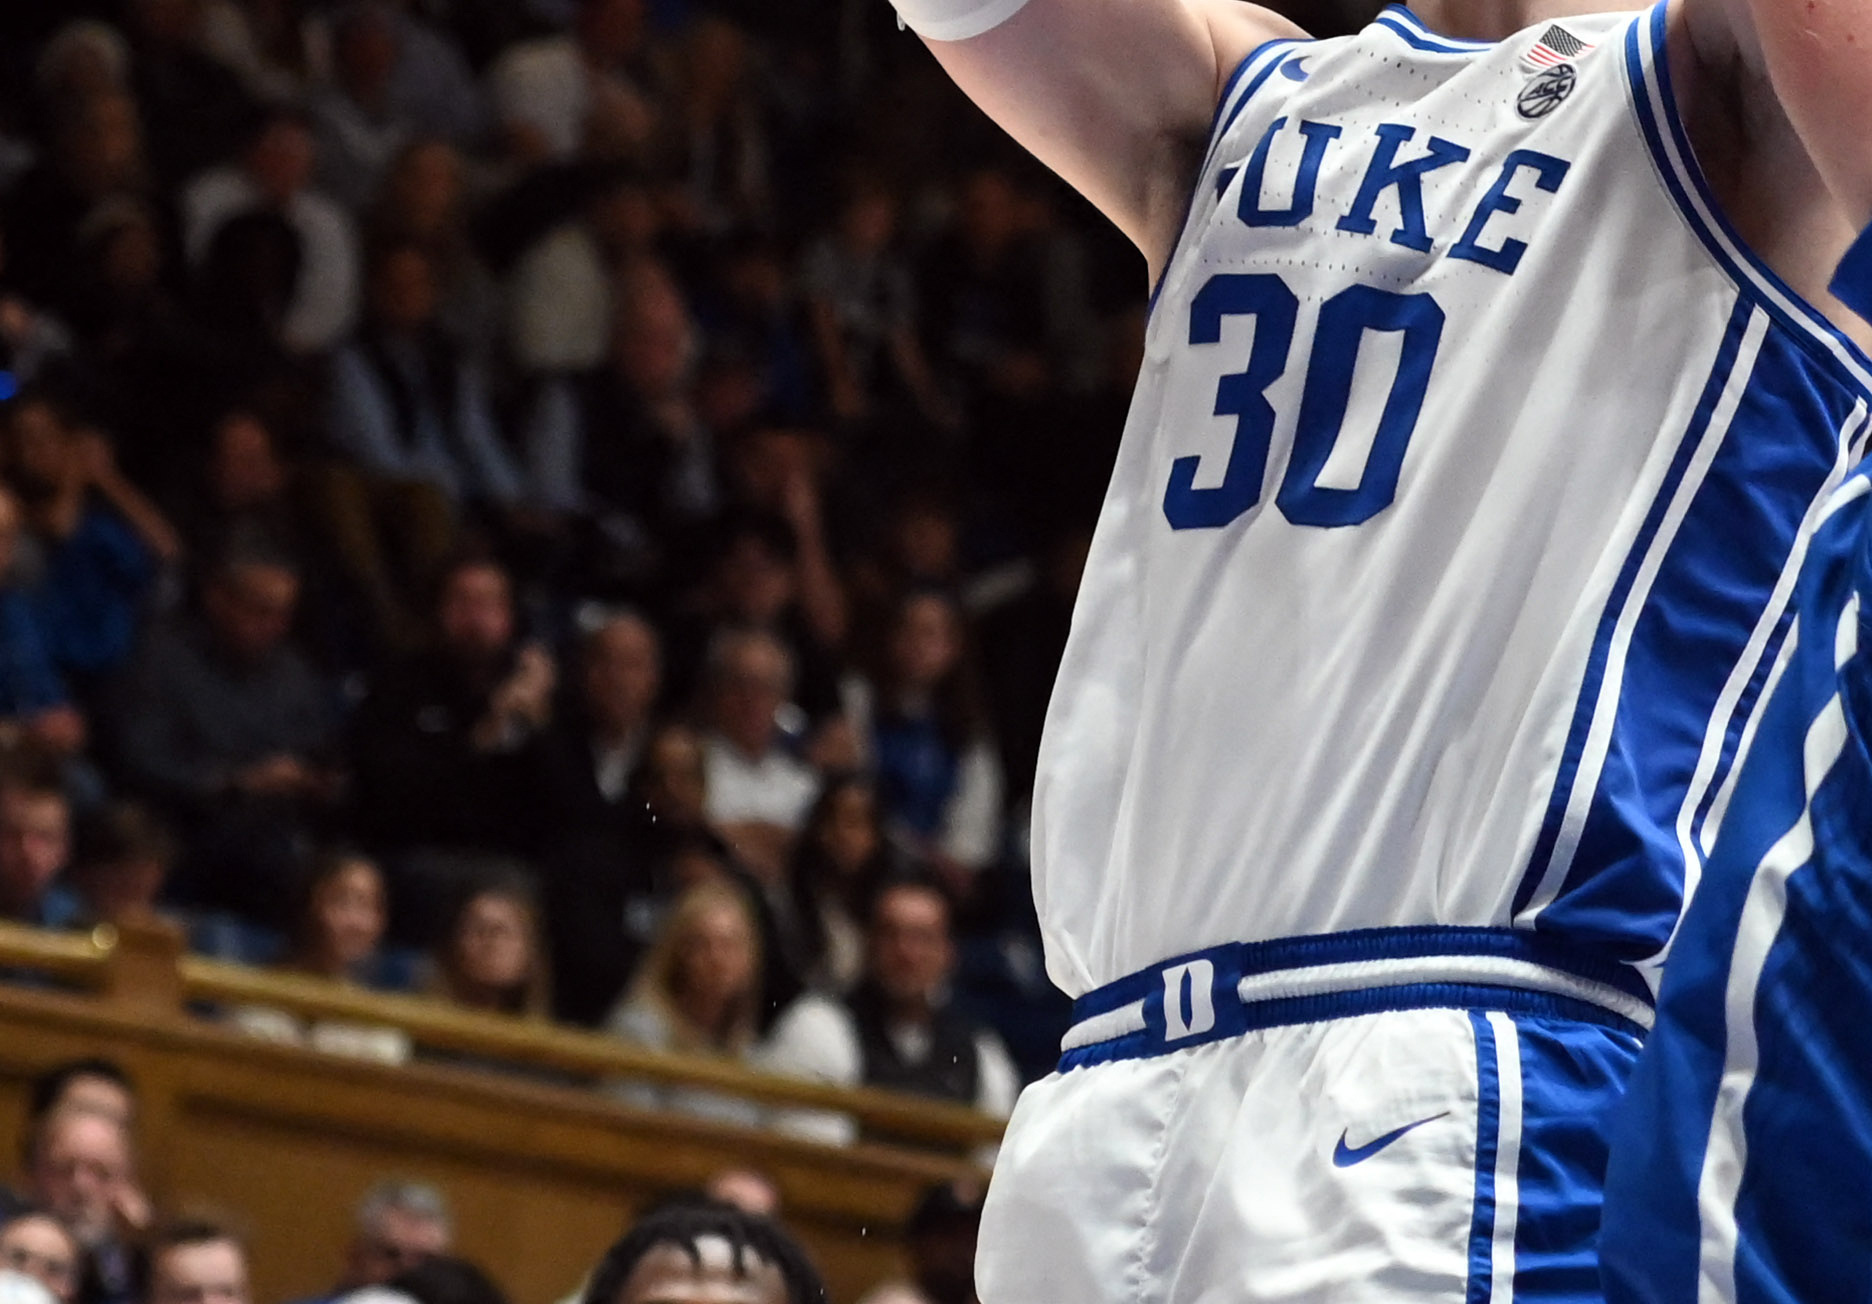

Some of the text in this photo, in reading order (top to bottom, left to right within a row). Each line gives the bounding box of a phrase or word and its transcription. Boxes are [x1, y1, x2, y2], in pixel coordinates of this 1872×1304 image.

[1216, 116, 1571, 276] UKE
[1163, 273, 1446, 530] 30
[1162, 958, 1216, 1042] D
